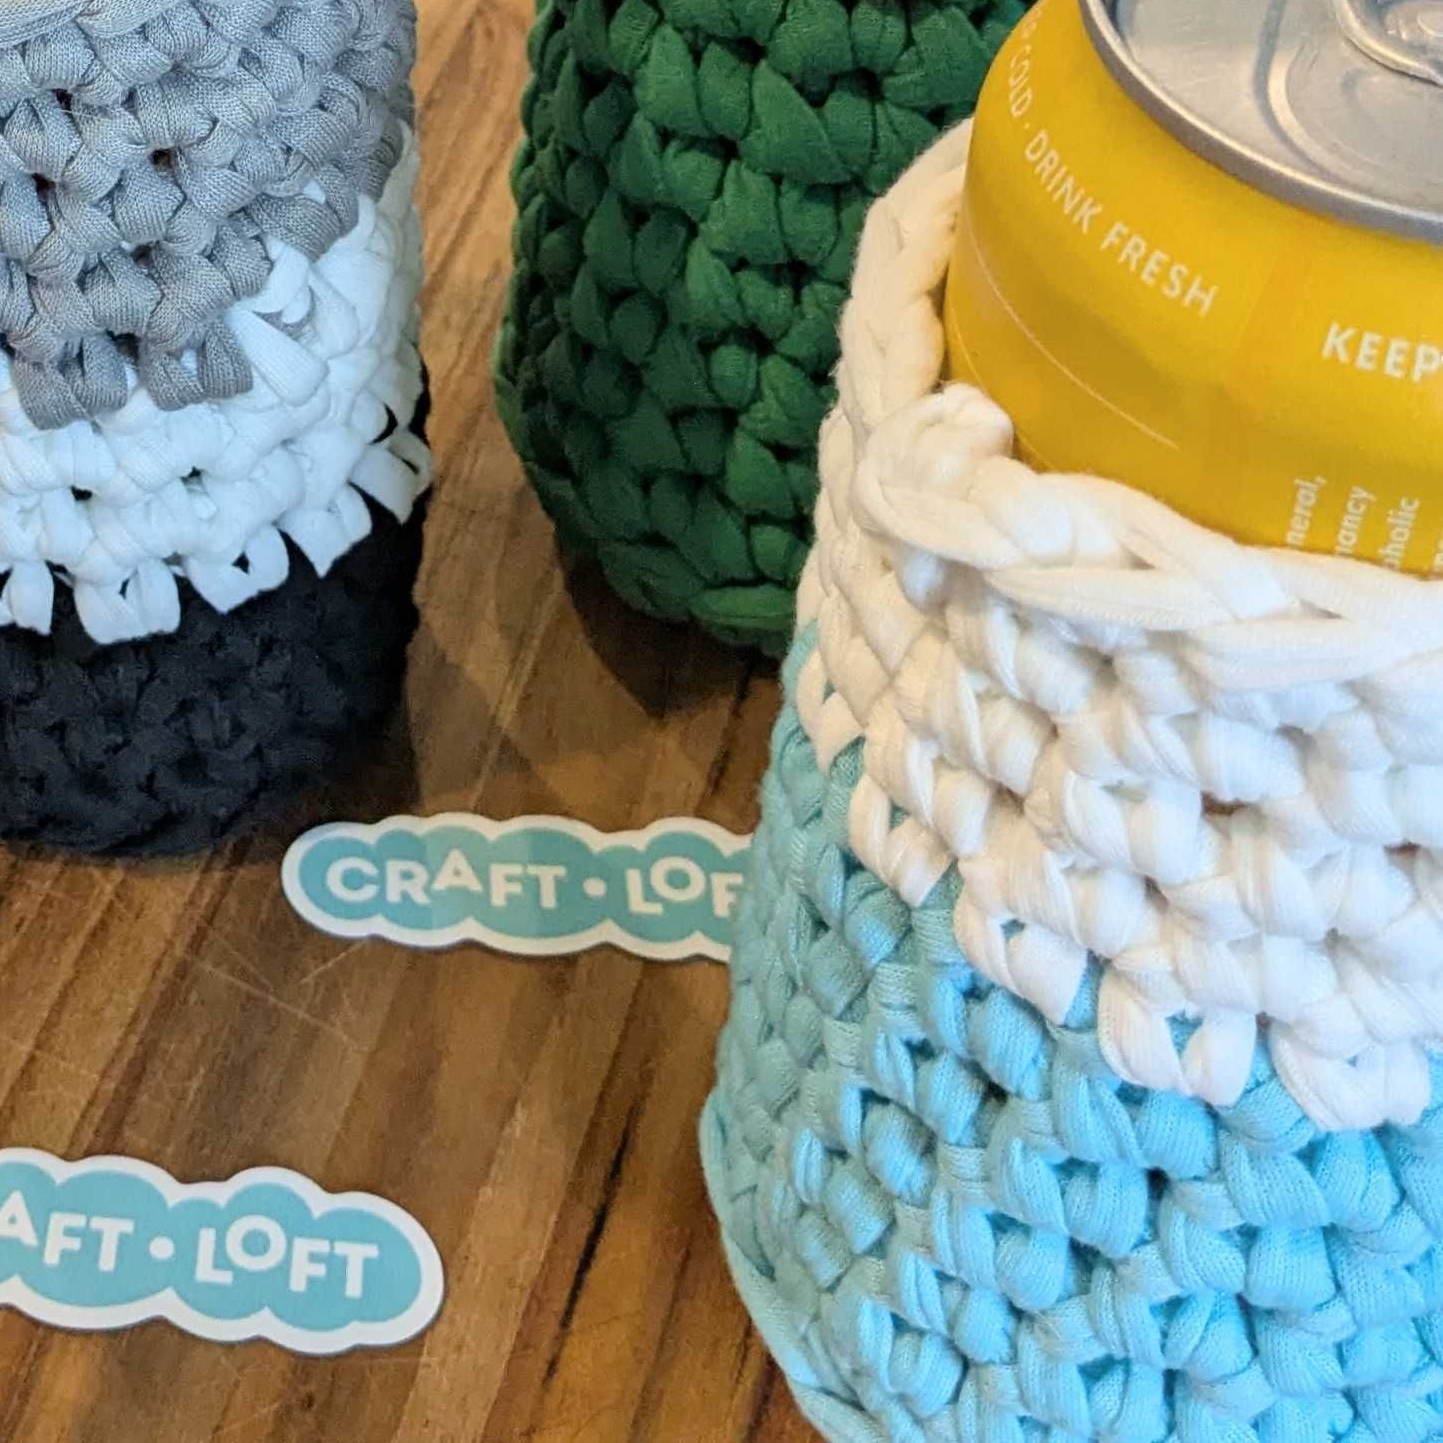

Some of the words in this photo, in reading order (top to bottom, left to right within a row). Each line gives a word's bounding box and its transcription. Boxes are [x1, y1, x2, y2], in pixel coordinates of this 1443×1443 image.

[1009, 44, 1034, 118] COLD
[1025, 129, 1103, 234] DRINK
[1101, 221, 1220, 319] FRESH
[326, 848, 568, 909] CRAFT
[625, 855, 746, 918] LOF
[195, 1214, 380, 1299] LOFT
